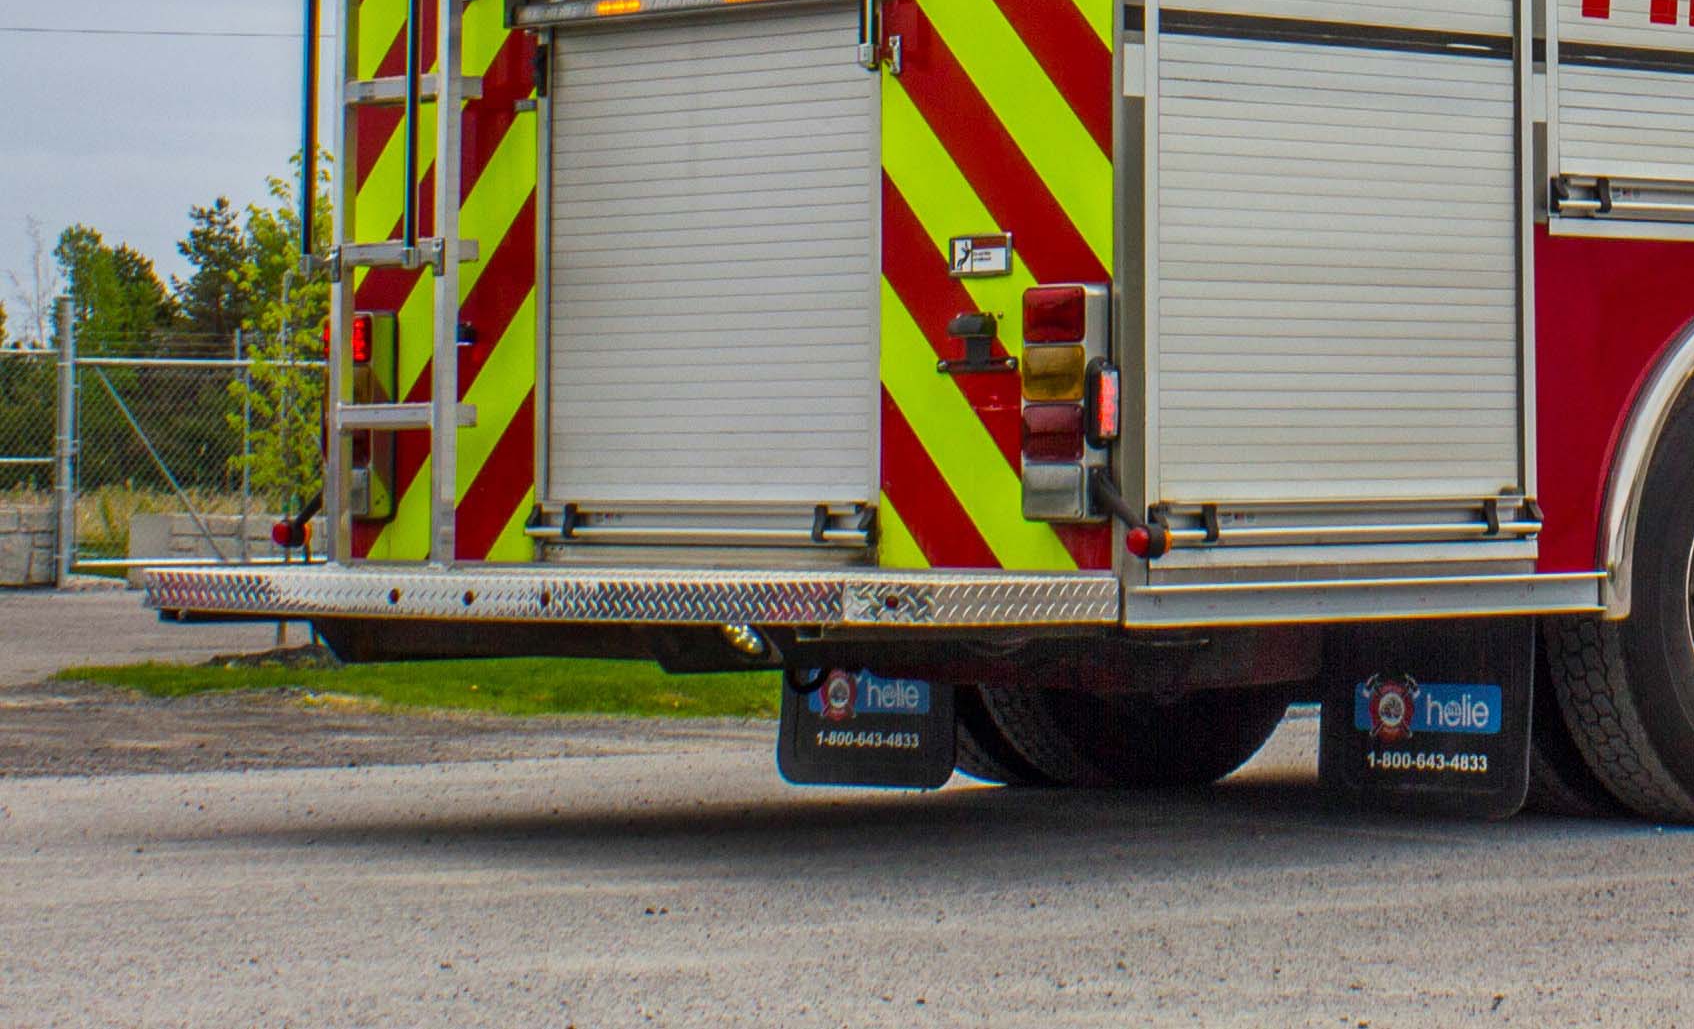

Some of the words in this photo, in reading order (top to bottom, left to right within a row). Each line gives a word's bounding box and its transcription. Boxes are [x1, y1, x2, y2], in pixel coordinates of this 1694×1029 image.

[866, 676, 919, 708] helie
[1426, 693, 1490, 728] helie
[816, 730, 920, 749] 1-800-643-4833
[1367, 751, 1489, 772] 1-800-643-4833
